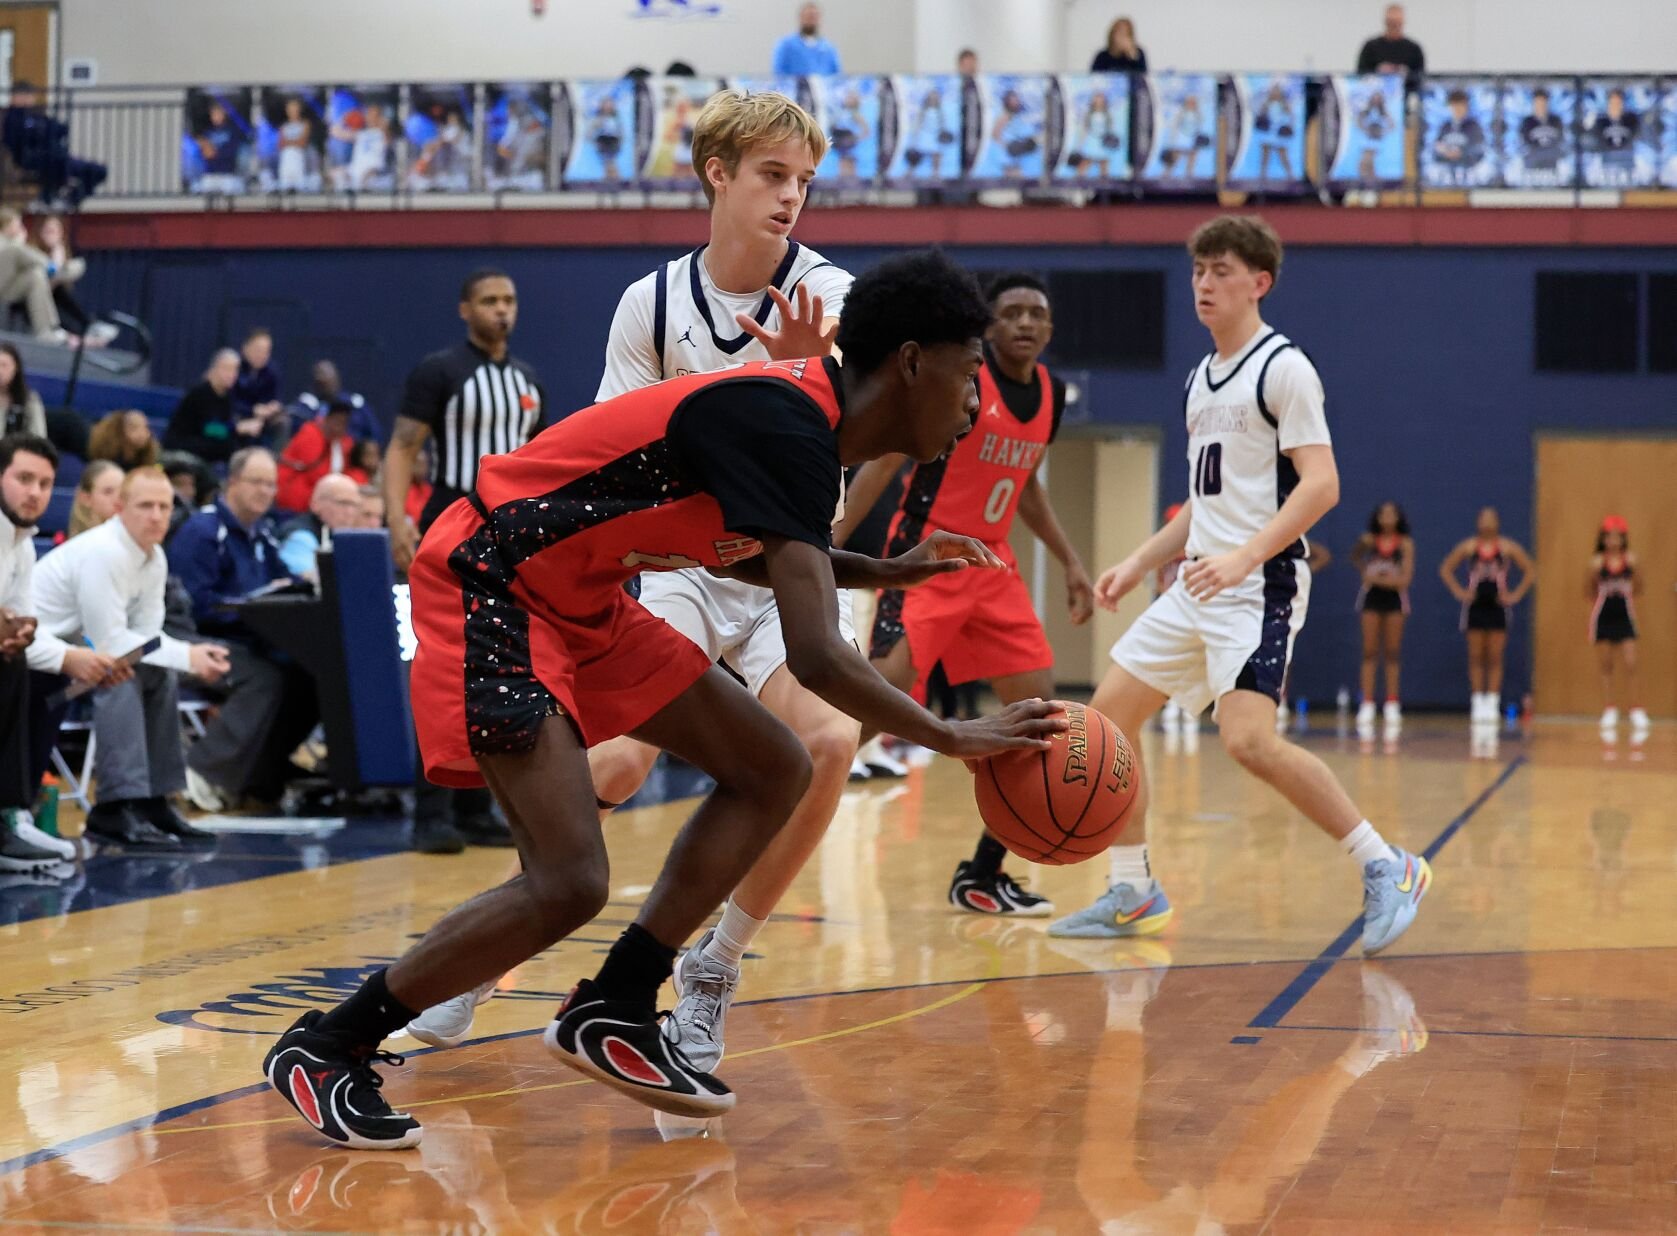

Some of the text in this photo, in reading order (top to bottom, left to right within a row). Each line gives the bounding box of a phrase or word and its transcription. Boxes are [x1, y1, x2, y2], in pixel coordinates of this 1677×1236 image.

[1195, 442, 1222, 497] 10
[983, 477, 1016, 524] 0
[1062, 702, 1088, 787] SPALDIN
[1106, 730, 1128, 794] LEGA
